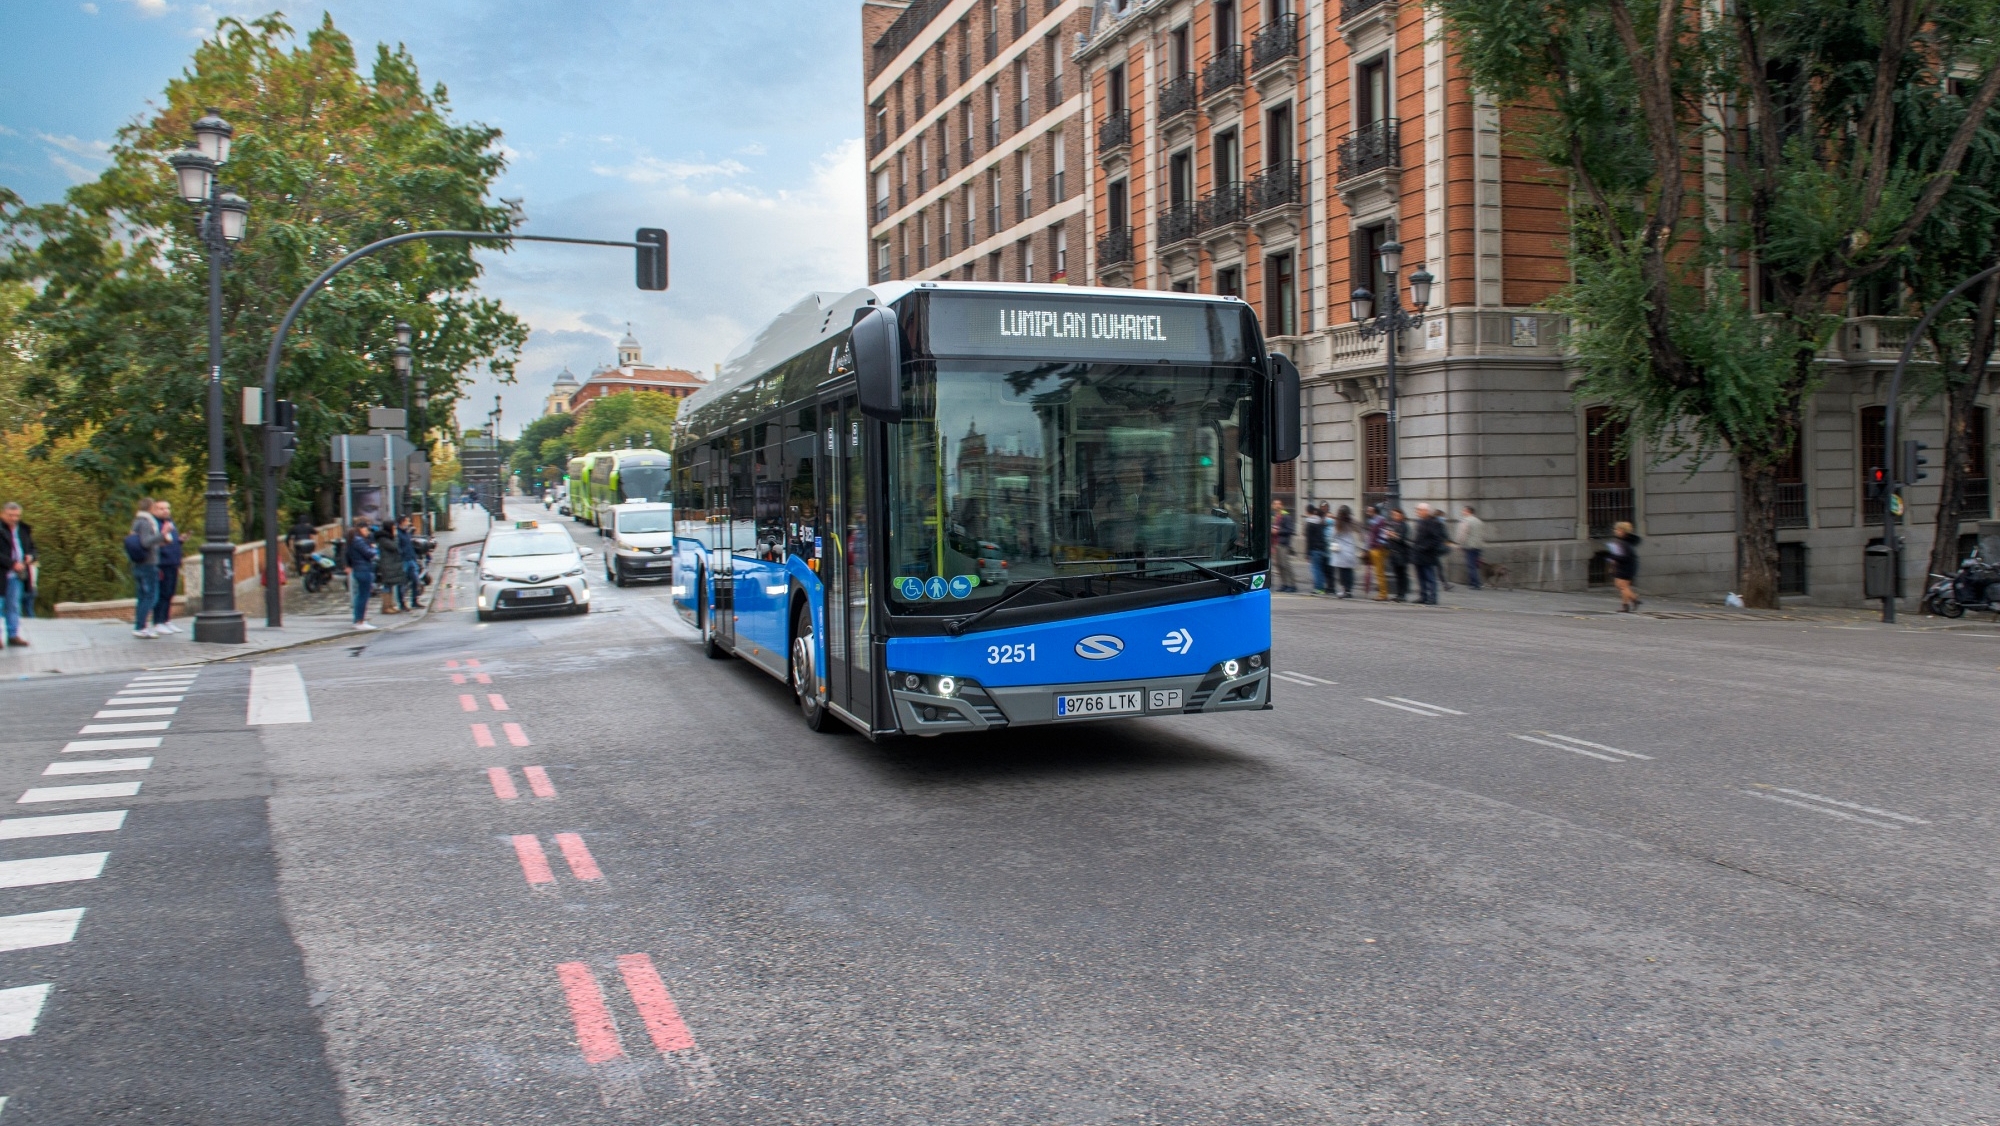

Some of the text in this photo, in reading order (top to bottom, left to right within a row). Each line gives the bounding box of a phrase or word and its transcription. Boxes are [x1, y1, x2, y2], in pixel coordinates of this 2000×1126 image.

[1000, 309, 1167, 341] LUMIPLAN DUHAMEL
[987, 643, 1036, 665] 3251
[1067, 694, 1136, 713] 9766 LTK
[1153, 691, 1179, 707] SP
